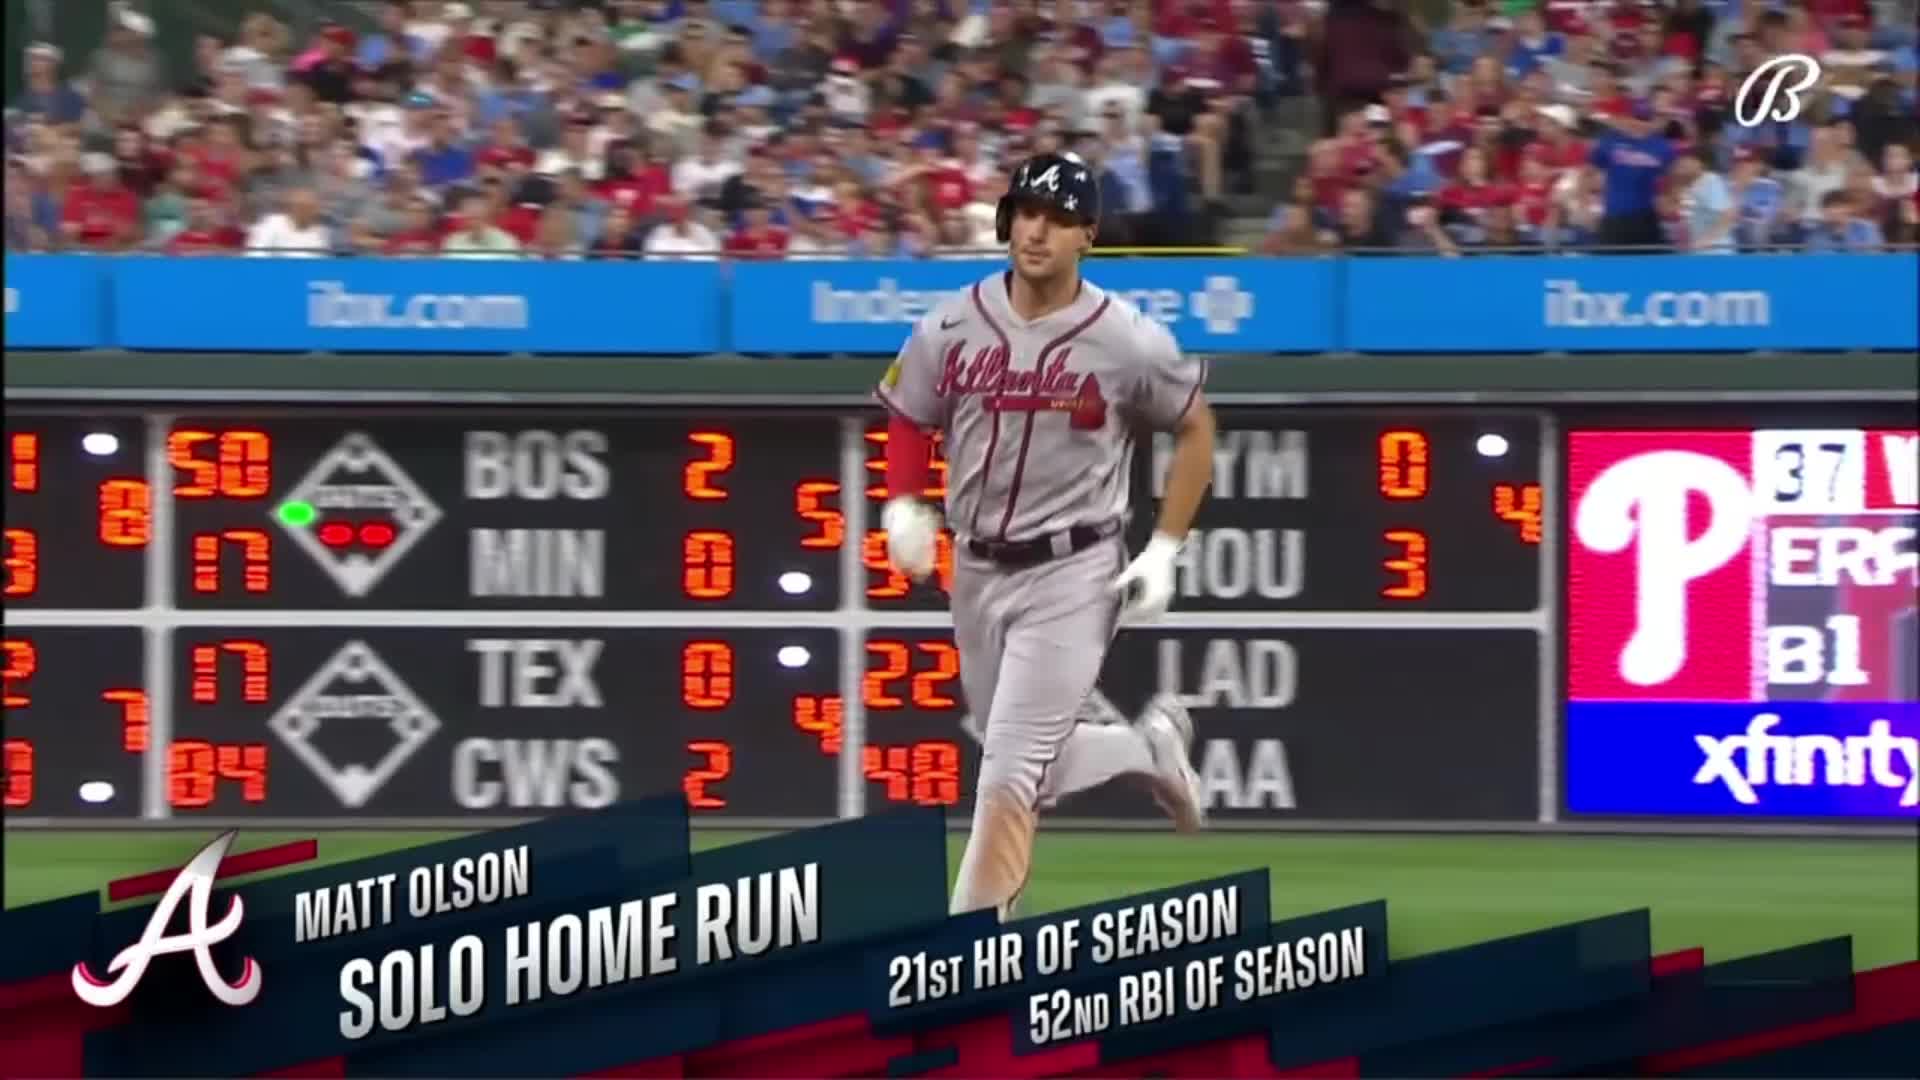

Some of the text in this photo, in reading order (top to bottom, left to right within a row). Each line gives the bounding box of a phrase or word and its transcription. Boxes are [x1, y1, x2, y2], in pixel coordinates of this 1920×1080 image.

[307, 280, 528, 328] ibx.com
[1544, 279, 1770, 327] ibx.com
[936, 338, 1080, 398] Atlanta
[167, 431, 270, 496] 50
[464, 430, 610, 499] BOS
[685, 432, 734, 498] 2
[1380, 432, 1429, 498] 0
[1774, 442, 1846, 502] 37
[797, 483, 845, 547] 5
[1494, 486, 1543, 543] 4
[470, 528, 604, 598] MIN
[684, 531, 734, 598] 0
[1381, 531, 1428, 597] 3
[466, 638, 606, 707] TEX
[682, 641, 734, 707] 0
[862, 641, 961, 707] 22
[1157, 638, 1298, 709] LAD
[101, 689, 151, 752] 7
[793, 695, 844, 754] 4
[452, 738, 620, 809] CWS
[683, 741, 734, 808] 2
[1692, 712, 1919, 807] xfinity
